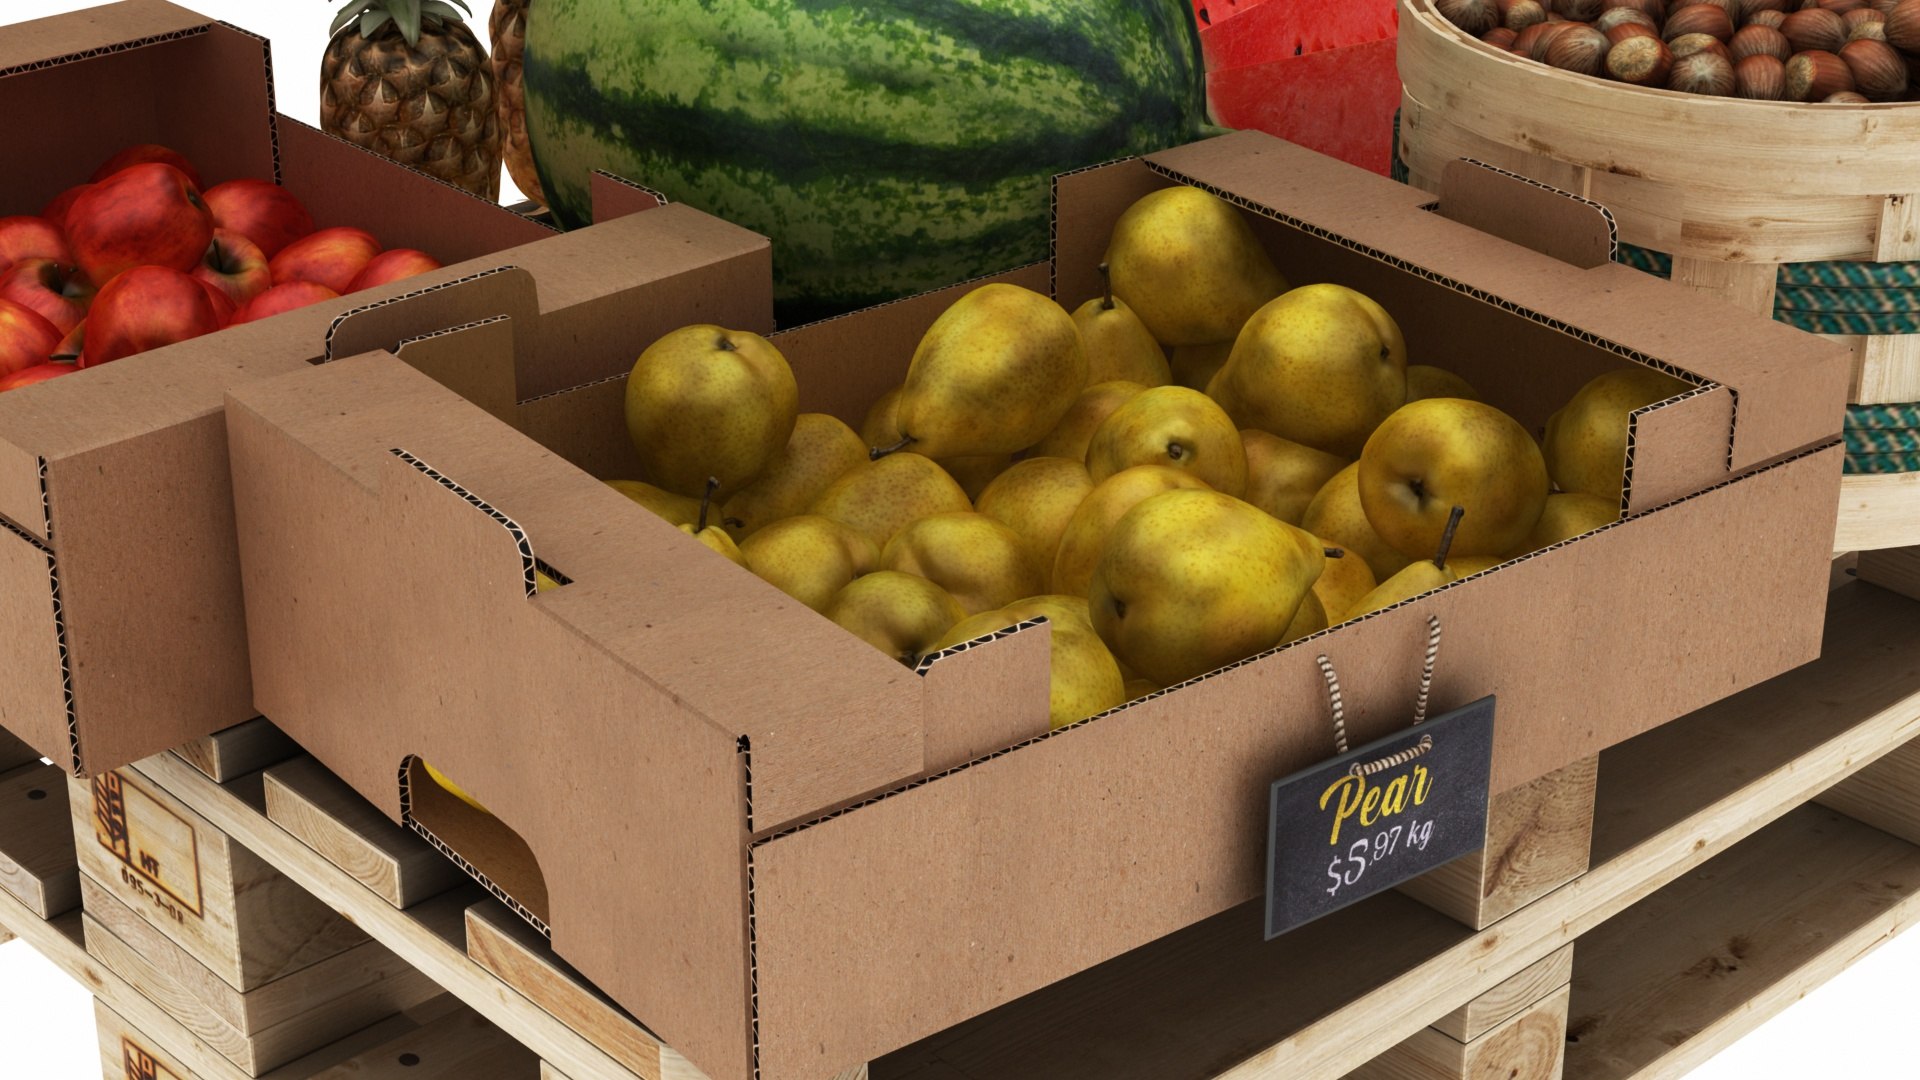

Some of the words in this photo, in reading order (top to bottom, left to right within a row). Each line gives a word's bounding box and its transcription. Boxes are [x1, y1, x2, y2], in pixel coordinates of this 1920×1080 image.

[1319, 765, 1433, 845] Pear
[1407, 819, 1434, 851] kg
[140, 850, 160, 879] HT
